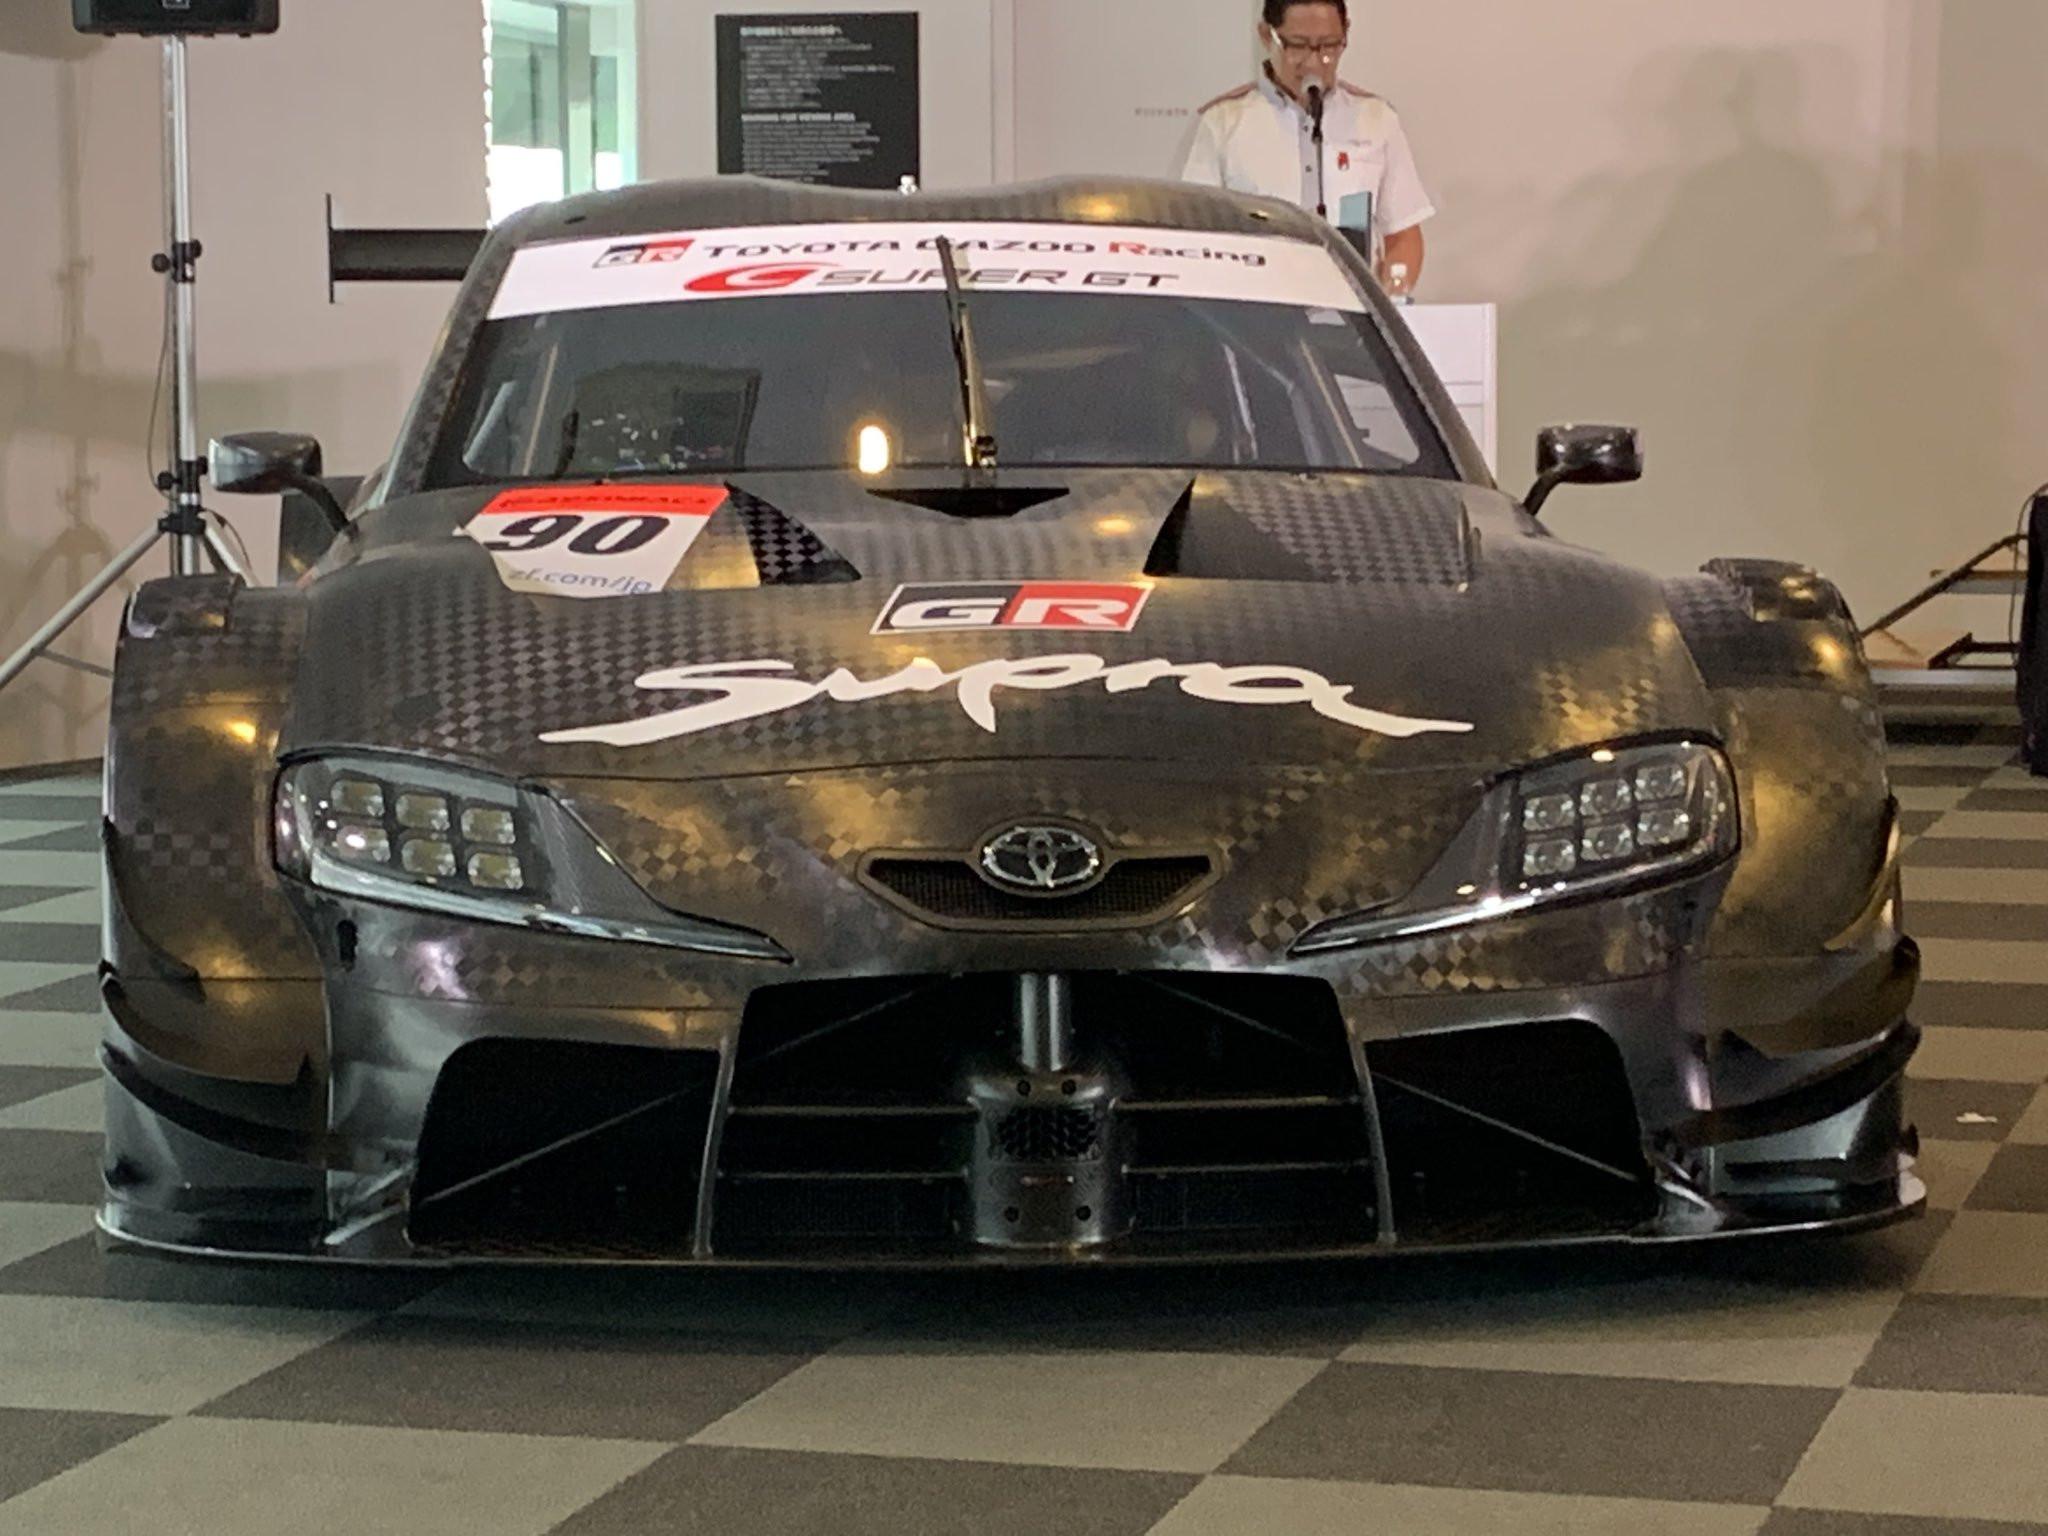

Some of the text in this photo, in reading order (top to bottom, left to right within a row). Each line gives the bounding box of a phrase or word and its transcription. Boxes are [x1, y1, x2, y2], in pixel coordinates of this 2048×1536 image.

[704, 240, 900, 258] TOYOTA
[916, 238, 1094, 254] GAZOO
[1109, 241, 1266, 267] Racing
[816, 268, 1067, 287] SUPER
[1082, 271, 1179, 288] GT
[483, 515, 670, 556] 90
[889, 597, 1130, 627] GR
[538, 653, 1475, 747] Supra
